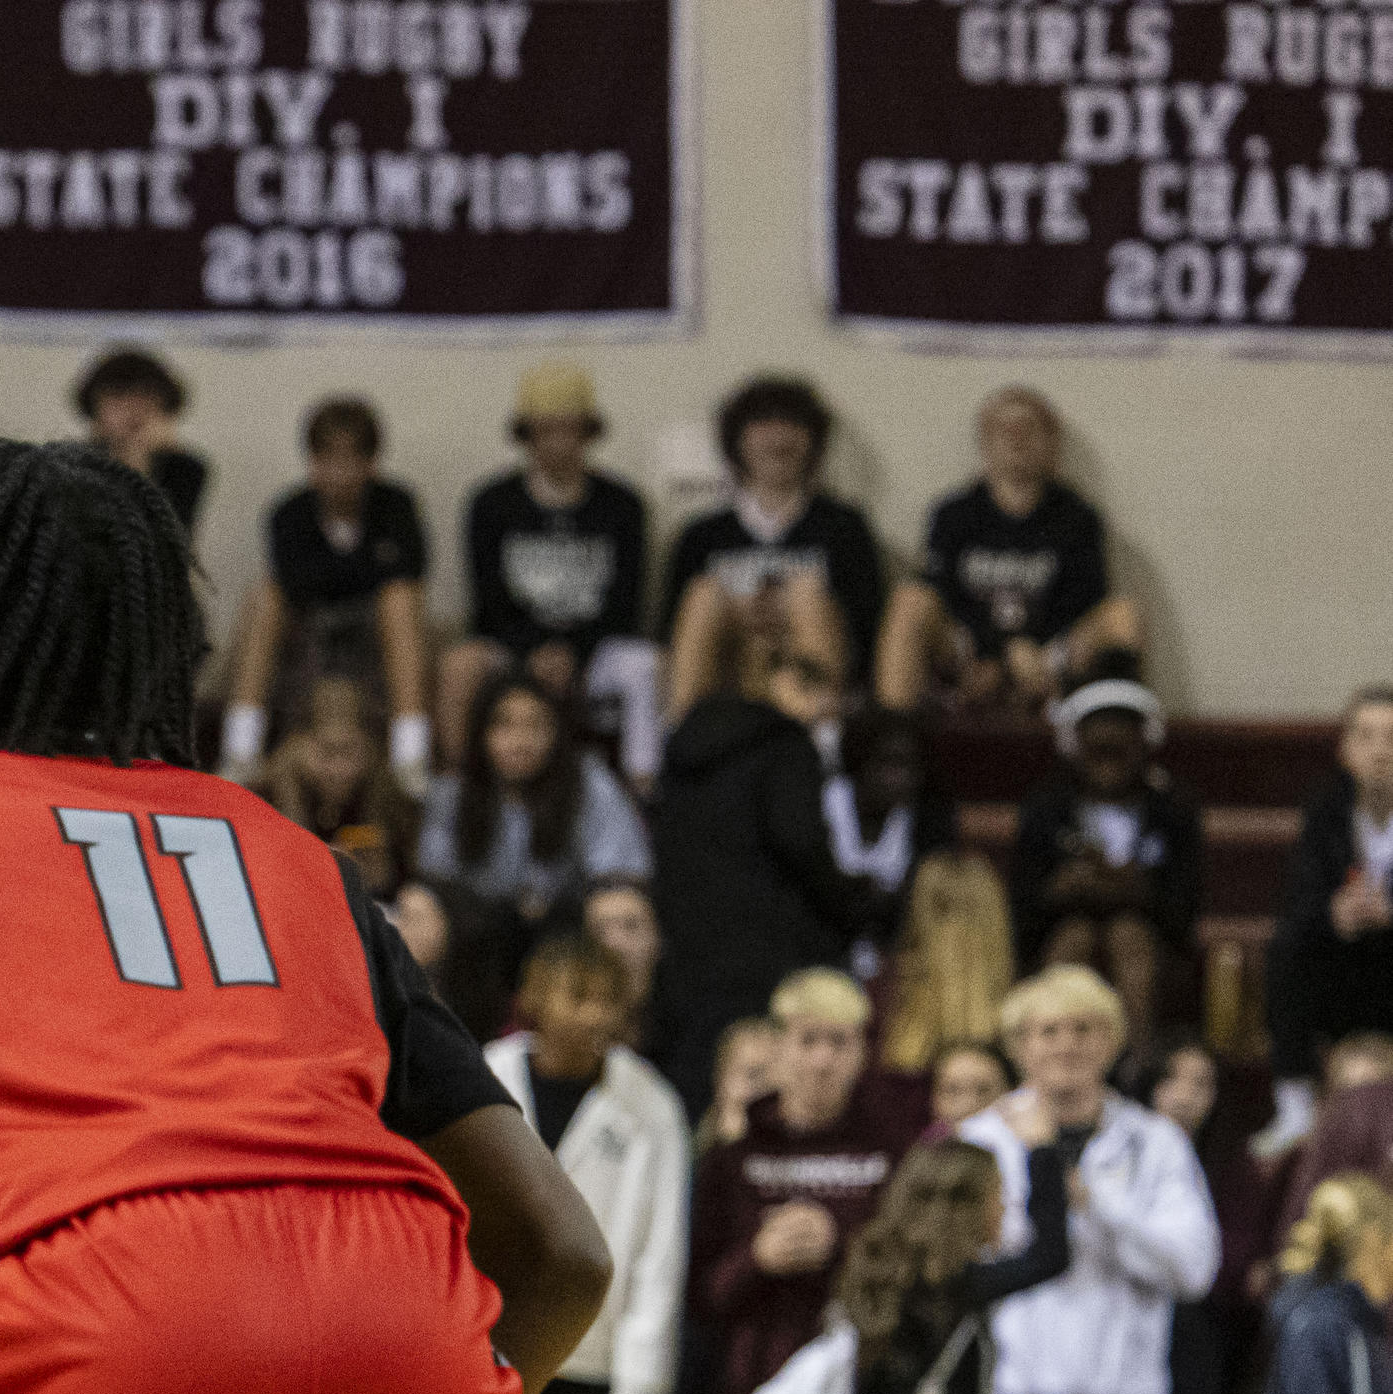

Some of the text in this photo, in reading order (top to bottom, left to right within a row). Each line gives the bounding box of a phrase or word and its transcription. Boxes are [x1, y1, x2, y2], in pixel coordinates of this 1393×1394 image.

[59, 0, 531, 80] GIRLS RUGBY
[957, 7, 1172, 86] GIRLS
[233, 146, 634, 233] CHAMPIONS
[855, 158, 1091, 244] STATE
[201, 225, 406, 308] 2016
[1105, 240, 1308, 324] 2017
[51, 806, 280, 990] 11
